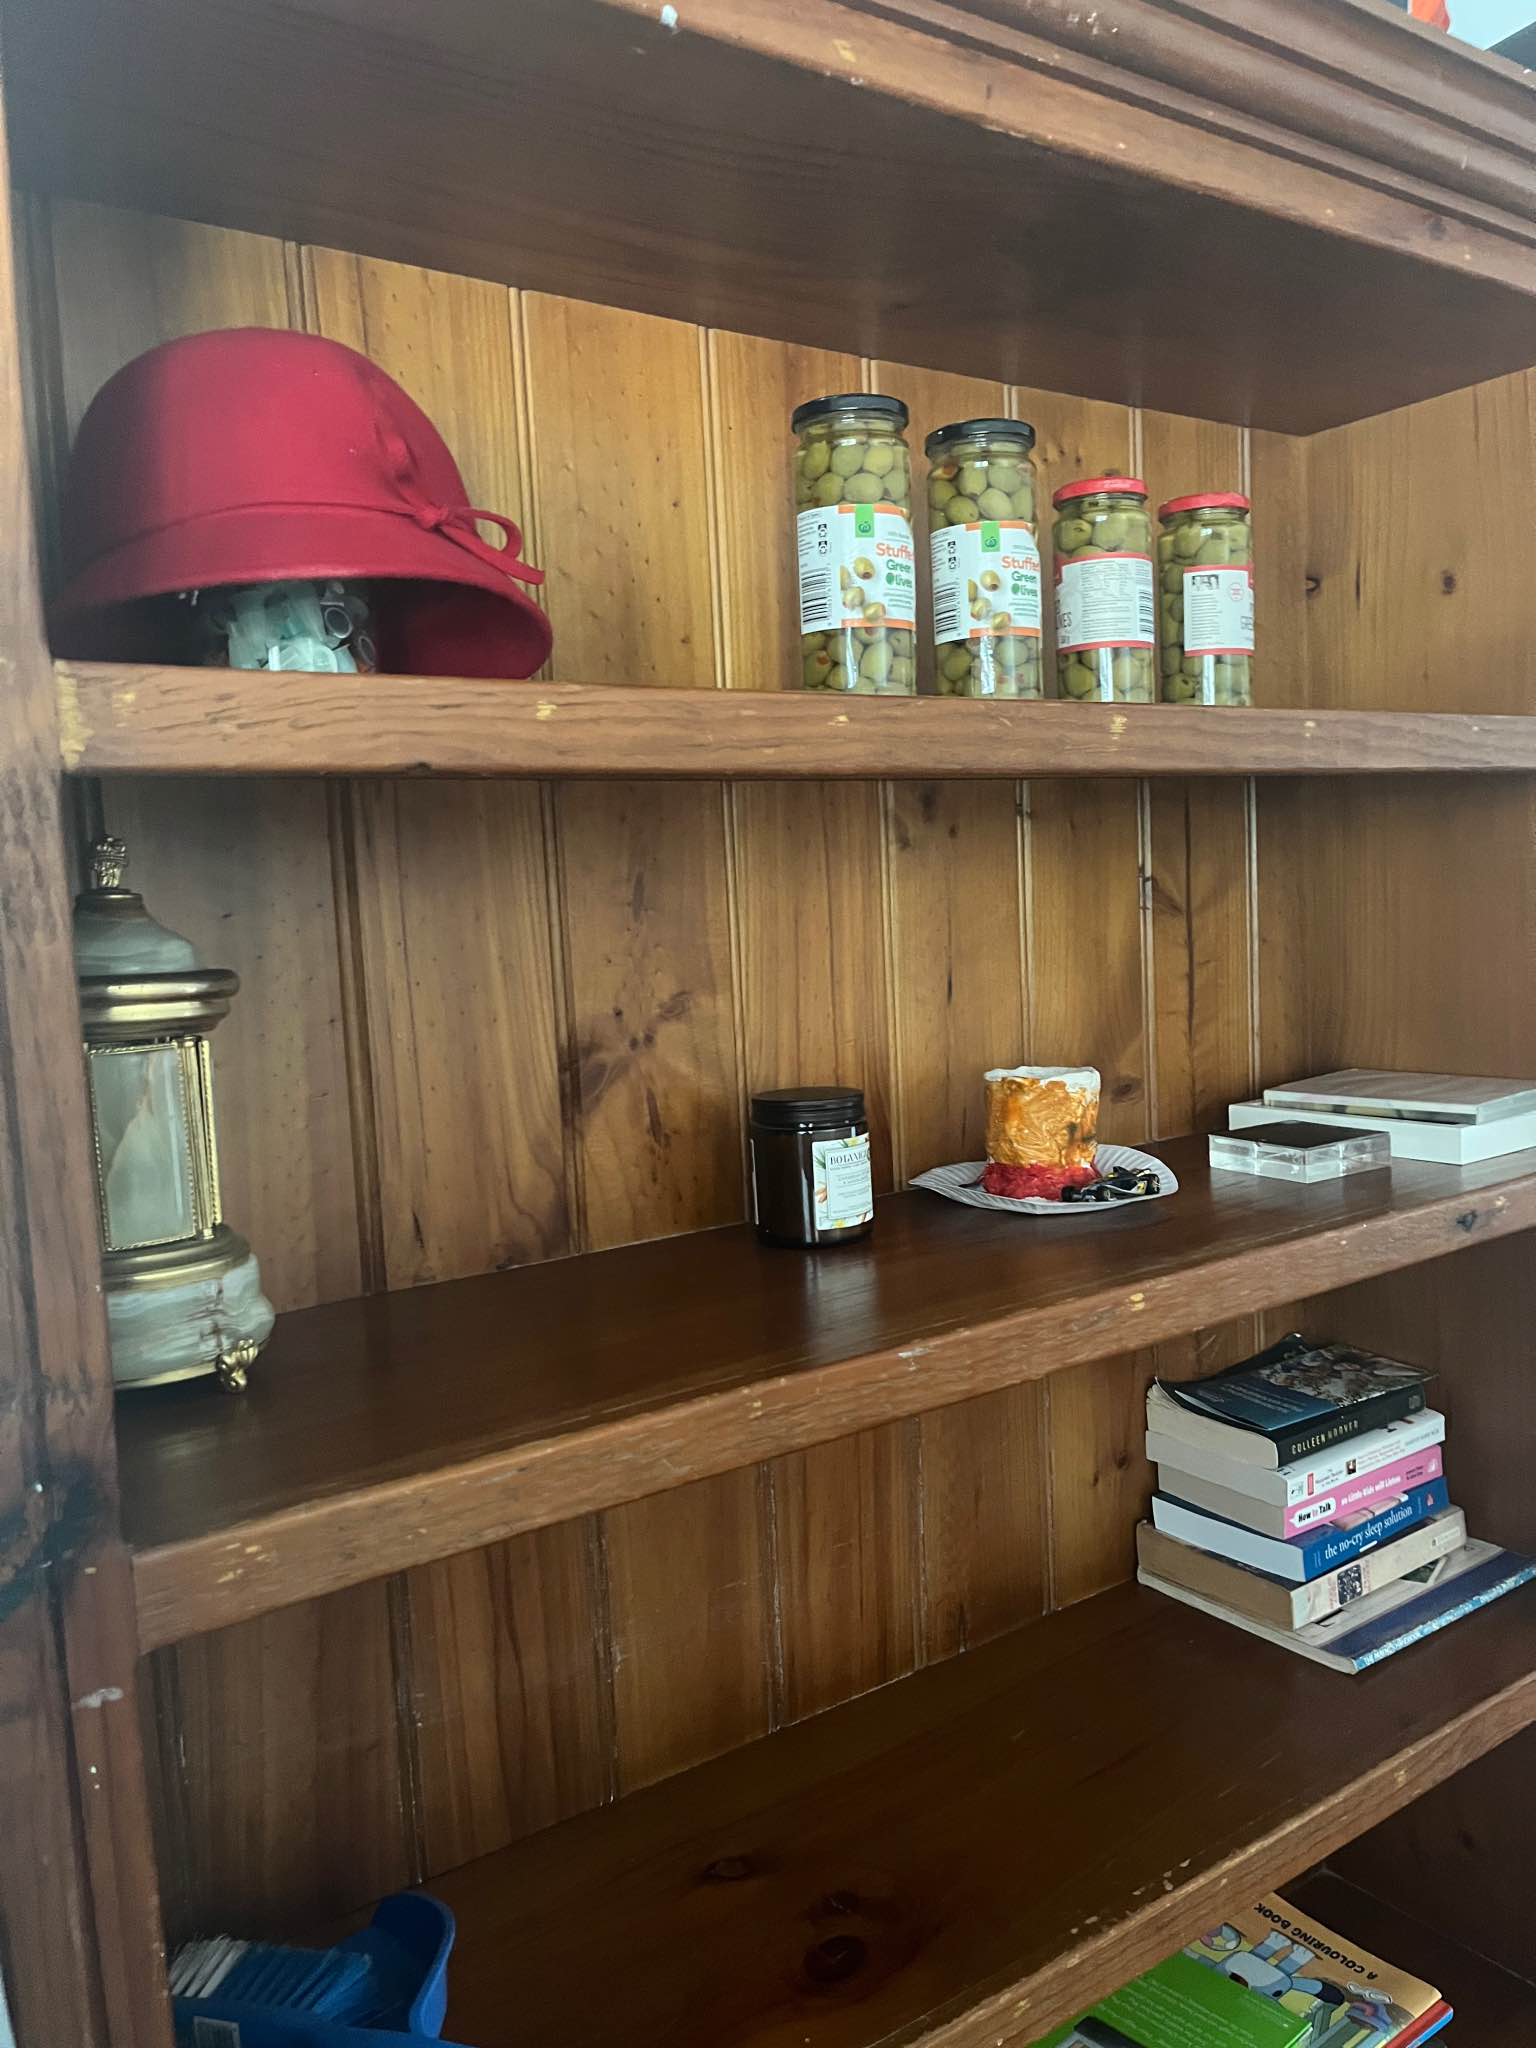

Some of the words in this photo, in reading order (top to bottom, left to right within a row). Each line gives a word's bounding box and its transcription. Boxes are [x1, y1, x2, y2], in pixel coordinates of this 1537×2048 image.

[1291, 1433, 1326, 1455] COLLEEN
[1327, 1419, 1359, 1440] HOOVER
[1298, 1511, 1311, 1523] How
[1319, 1502, 1331, 1515] Talk
[1363, 1484, 1375, 1496] Kids
[1324, 1543, 1338, 1560] the
[1339, 1532, 1363, 1551] no-cry
[1364, 1522, 1383, 1538] sleep
[1383, 1505, 1413, 1527] solution
[1253, 1902, 1292, 1930] BOOK
[1291, 1927, 1366, 1974] COLOURING
[1366, 1970, 1379, 1980] A
